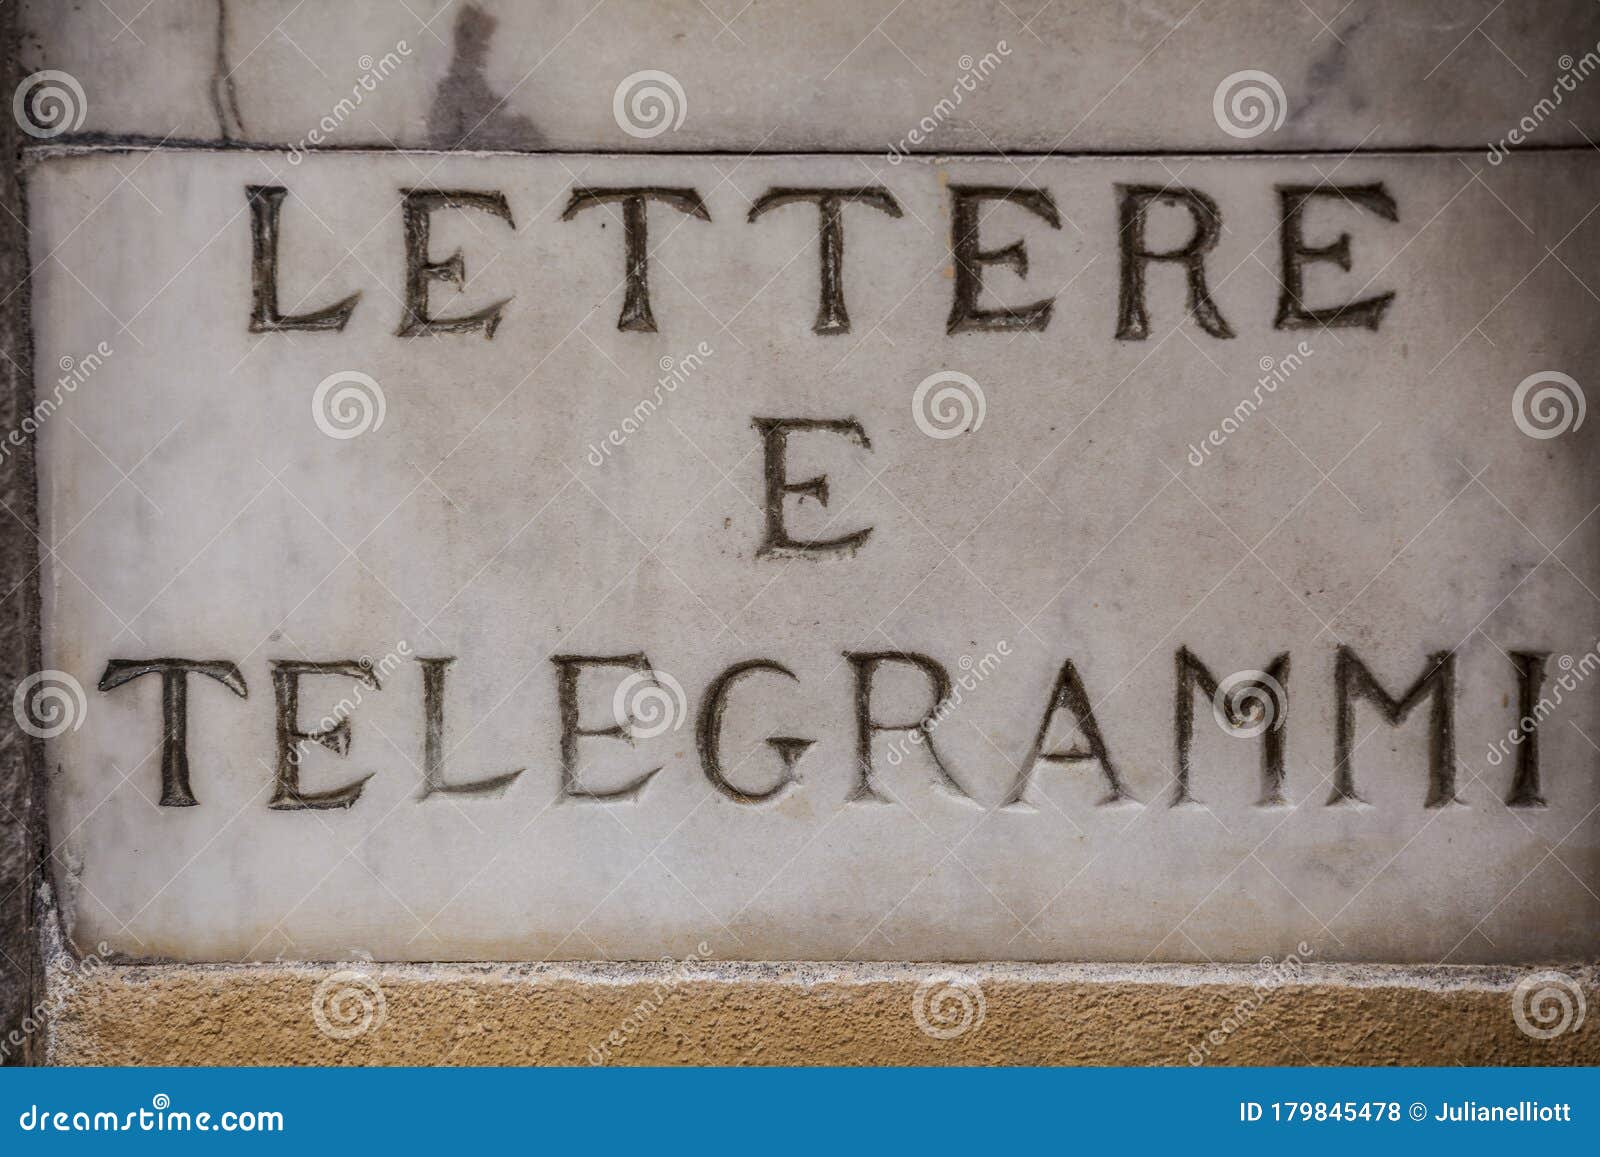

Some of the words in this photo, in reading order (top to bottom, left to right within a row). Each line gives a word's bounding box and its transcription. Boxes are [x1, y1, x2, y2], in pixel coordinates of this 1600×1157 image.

[244, 182, 1399, 340] LETTERE
[751, 415, 874, 561] E
[98, 644, 1553, 811] TELEGRAMMI
